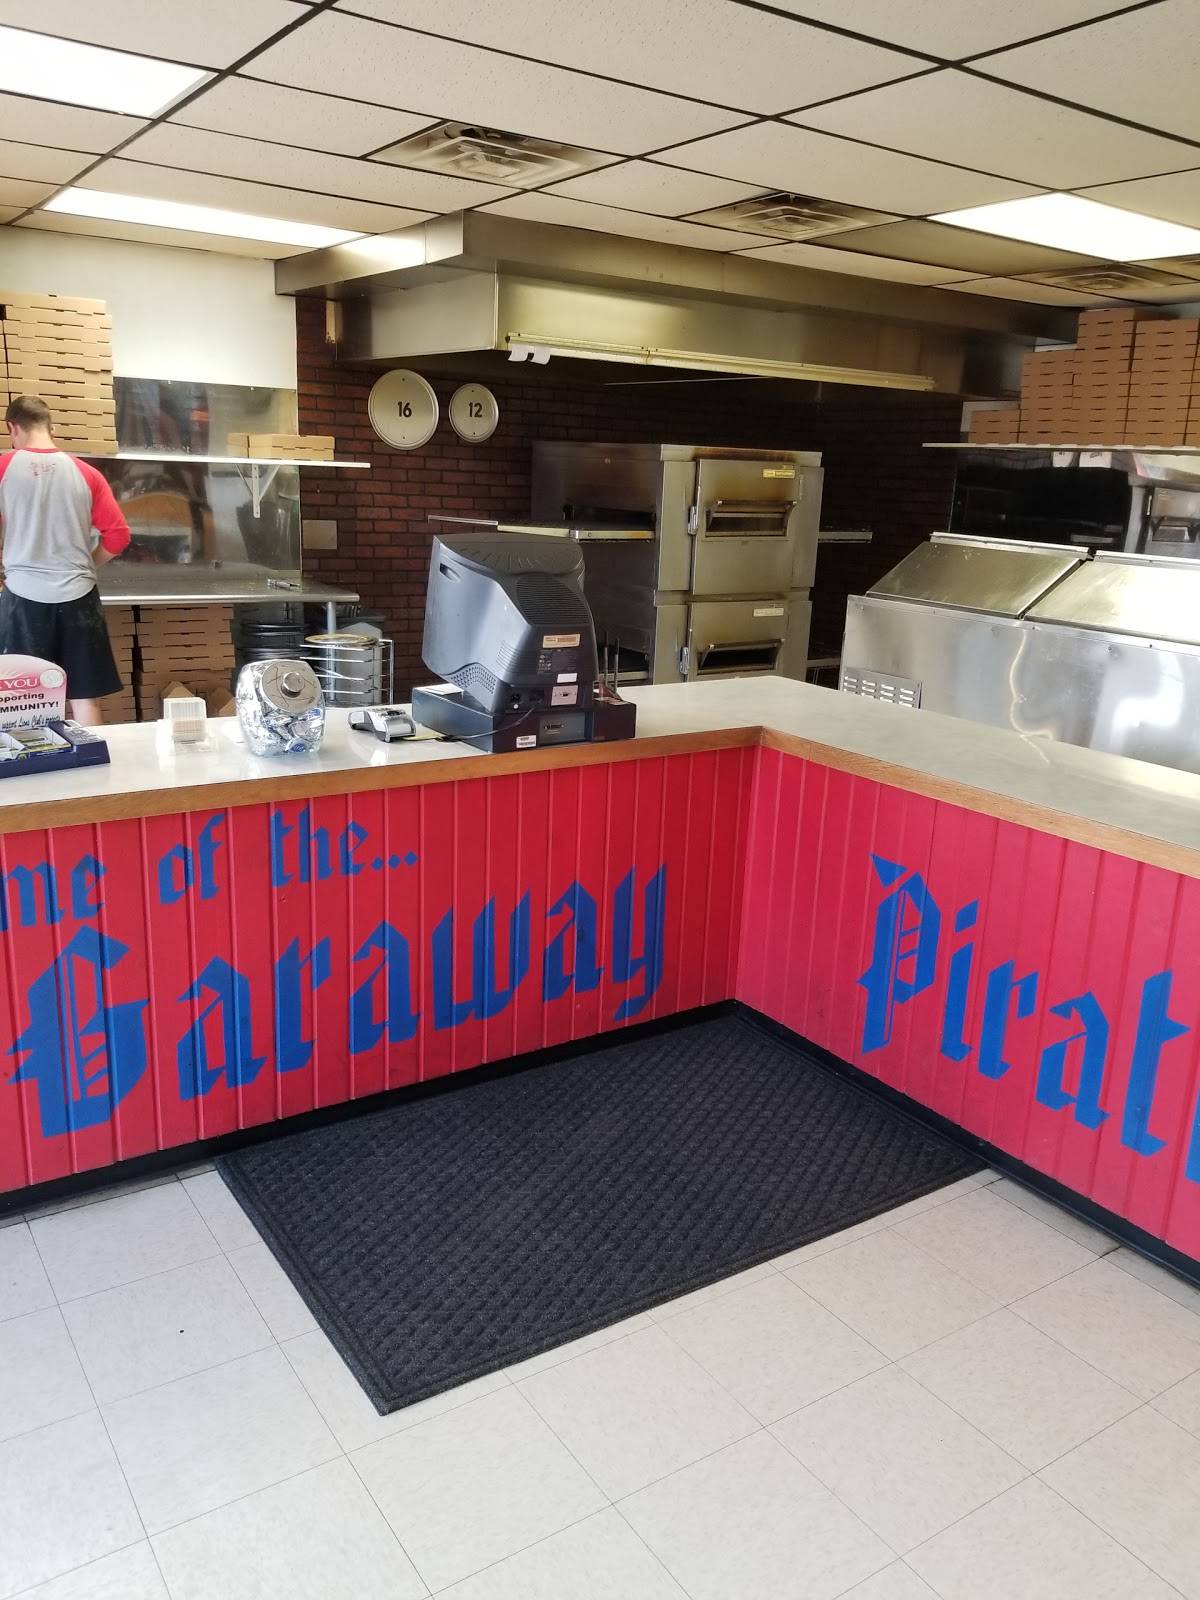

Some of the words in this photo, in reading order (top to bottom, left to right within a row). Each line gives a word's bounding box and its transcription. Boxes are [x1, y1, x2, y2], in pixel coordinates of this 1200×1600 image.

[397, 401, 413, 418] 16
[468, 402, 483, 418] 12
[4, 678, 38, 689] YOU
[157, 812, 224, 905] of
[7, 863, 667, 1137] Garaway
[857, 852, 1200, 1184] Pirat
